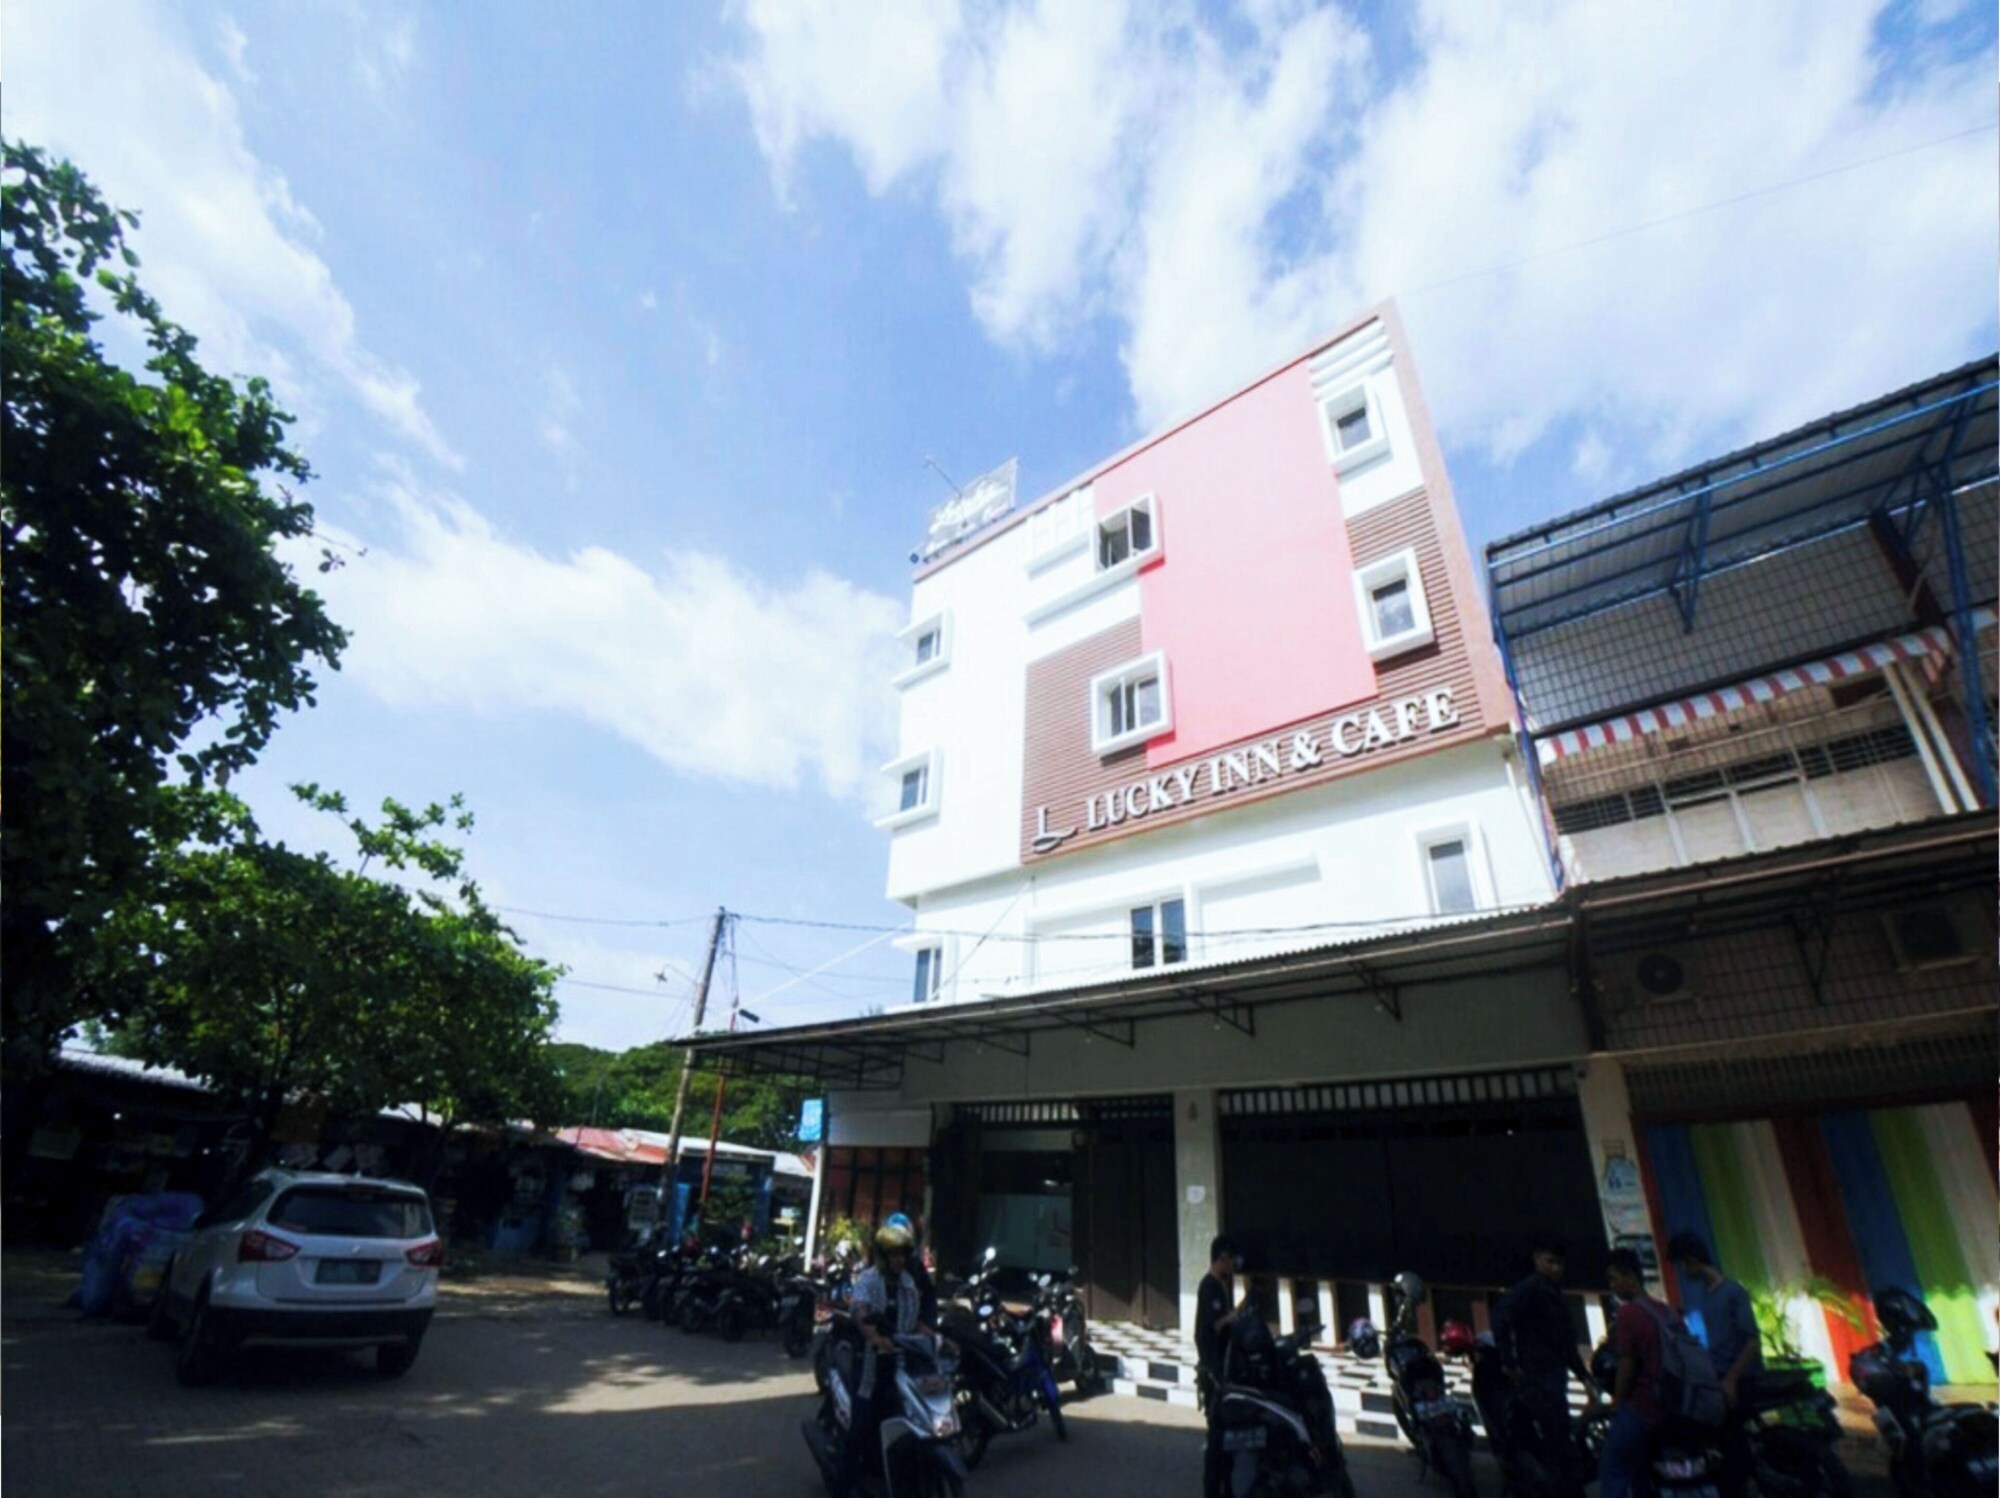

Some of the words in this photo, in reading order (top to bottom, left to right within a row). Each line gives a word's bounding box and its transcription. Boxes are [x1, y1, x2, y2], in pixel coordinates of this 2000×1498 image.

[1086, 766, 1200, 831] LUCKY
[1208, 738, 1283, 796] INN
[1290, 731, 1323, 773] &
[1331, 686, 1461, 759] CAFE
